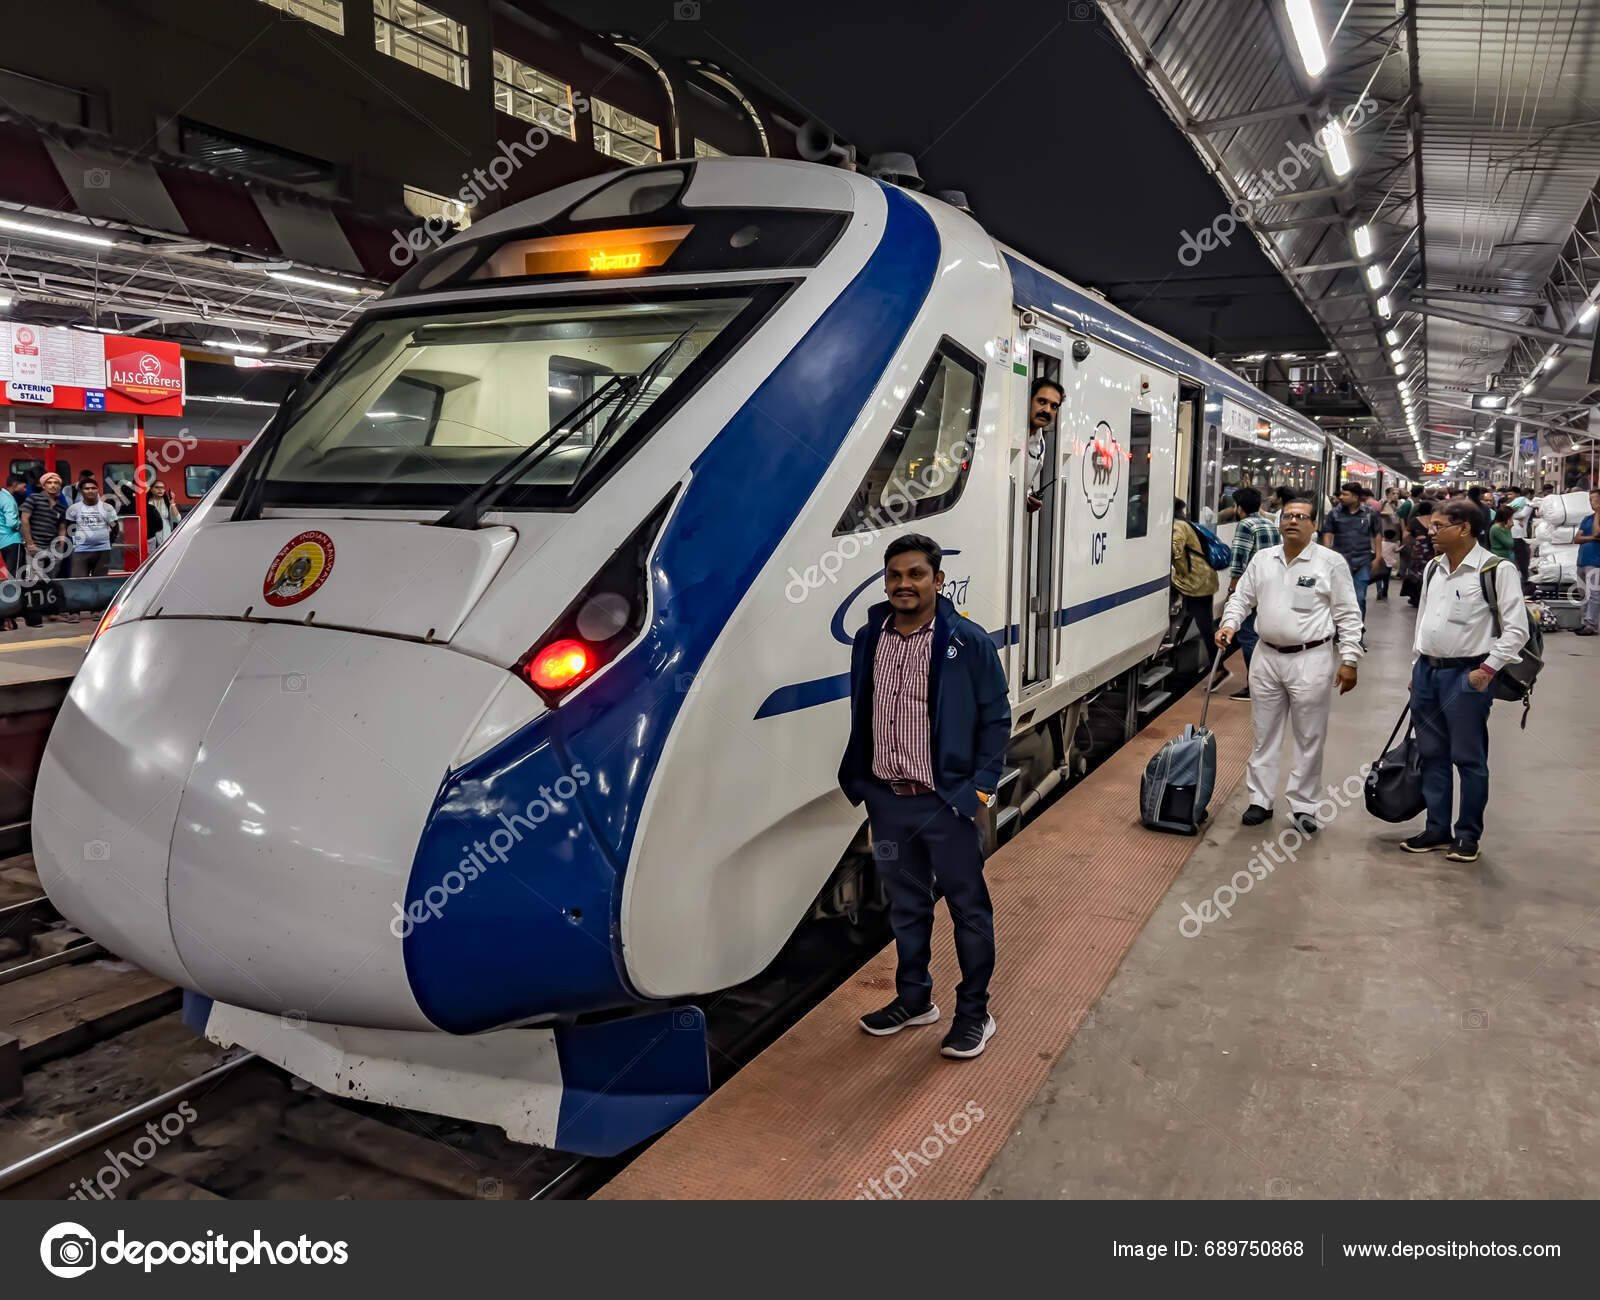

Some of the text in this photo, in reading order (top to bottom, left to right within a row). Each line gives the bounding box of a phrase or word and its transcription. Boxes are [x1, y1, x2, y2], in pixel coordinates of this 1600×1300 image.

[135, 372, 181, 388] Caterers
[12, 382, 52, 393] CATERING
[20, 392, 44, 401] STALL
[300, 531, 328, 544] INDIAN
[1091, 532, 1107, 565] ICF
